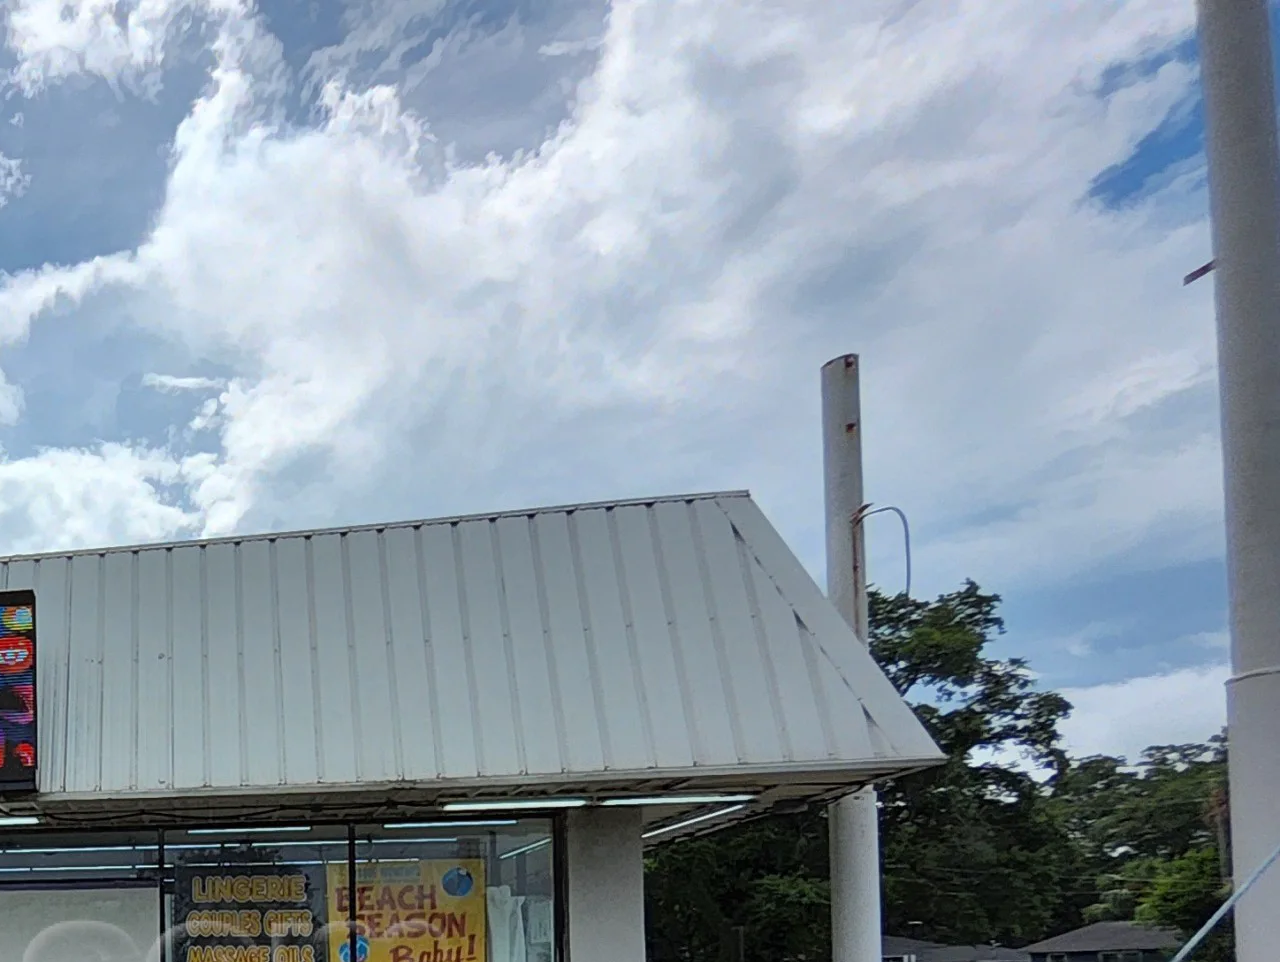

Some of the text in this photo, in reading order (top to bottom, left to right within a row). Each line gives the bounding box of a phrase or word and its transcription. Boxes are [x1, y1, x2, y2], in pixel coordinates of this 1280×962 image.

[192, 874, 307, 903] LINGERIE
[335, 884, 438, 912] BEACH
[186, 908, 313, 937] COUPLES GIFTS
[345, 912, 466, 939] SEASON
